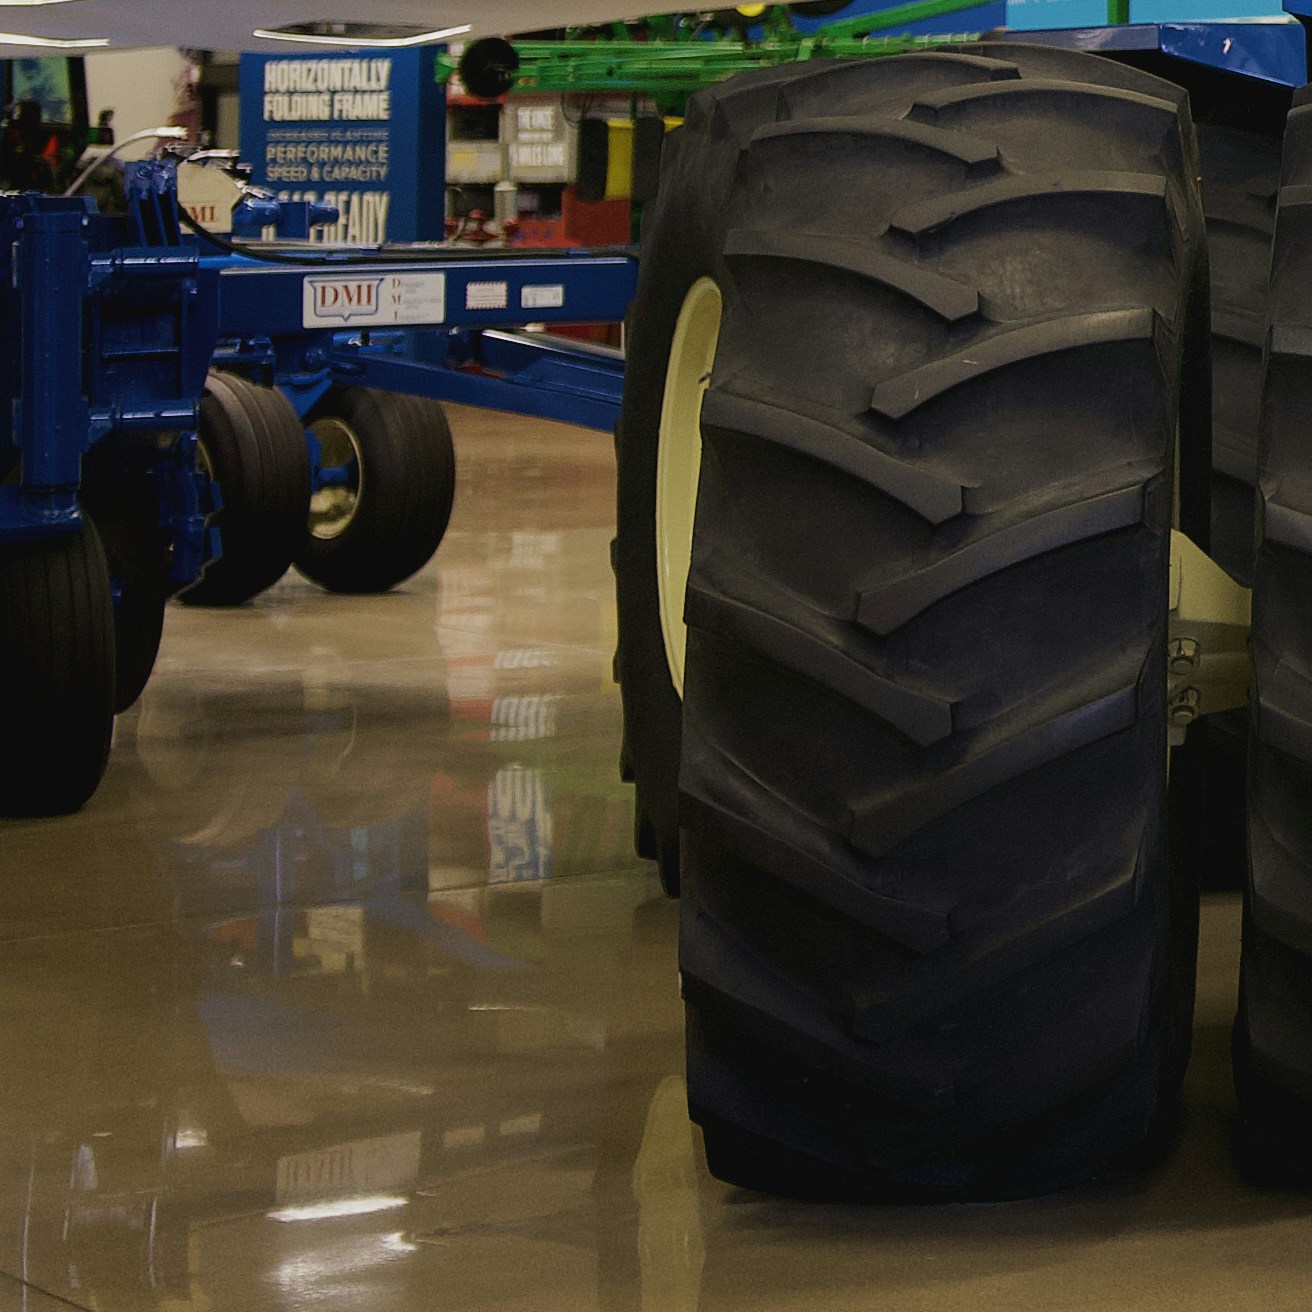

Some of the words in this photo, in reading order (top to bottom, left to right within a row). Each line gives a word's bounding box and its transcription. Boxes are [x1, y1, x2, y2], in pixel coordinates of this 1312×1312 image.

[264, 58, 392, 91] HORIZONTALLY
[263, 92, 331, 121] FOLDING
[333, 91, 391, 121] FRAME
[266, 142, 389, 163] PERFORMANCE
[266, 165, 308, 182] SPEED
[323, 163, 388, 181] CAPACITY
[190, 206, 215, 223] MI
[319, 283, 372, 309] DMI
